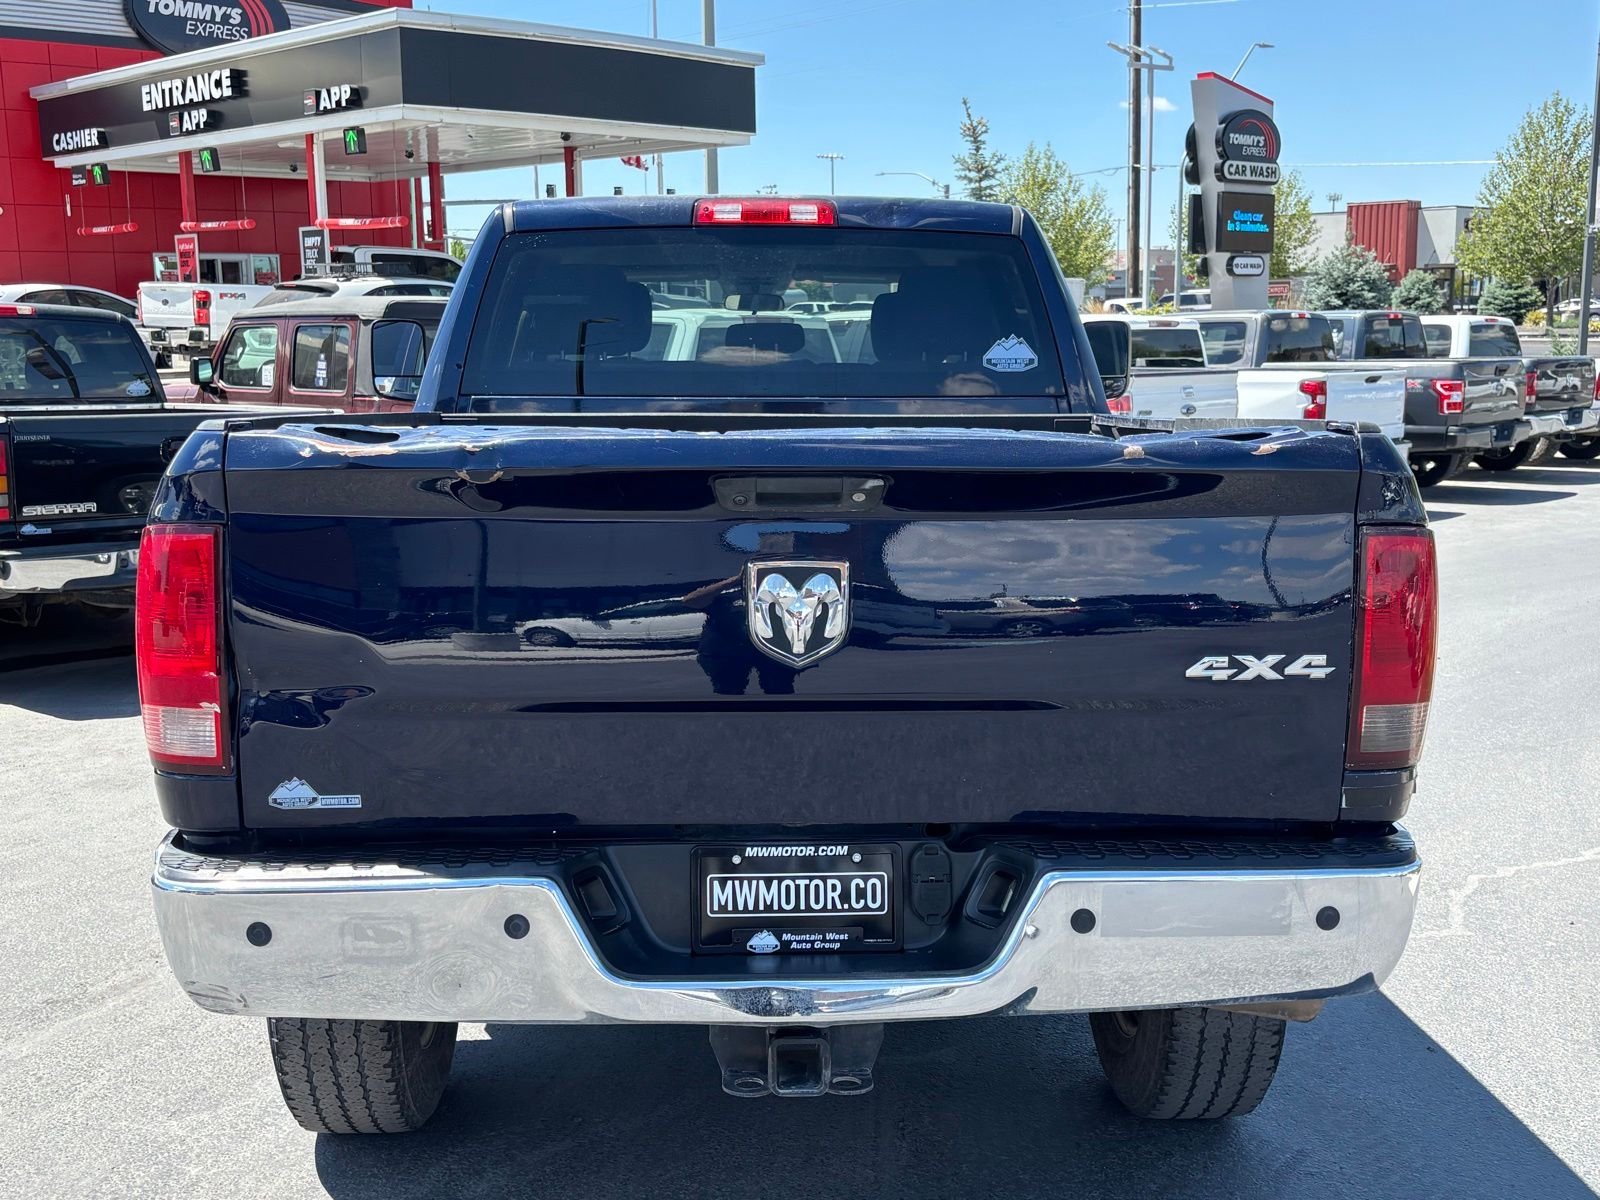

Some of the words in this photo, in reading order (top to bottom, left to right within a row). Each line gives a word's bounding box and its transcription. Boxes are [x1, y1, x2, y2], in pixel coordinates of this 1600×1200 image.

[147, 0, 243, 24] TOMMY'S
[185, 20, 248, 40] EXPRESS
[141, 68, 233, 112] ENTRANCE
[319, 84, 351, 111] APP
[182, 108, 208, 132] APP
[52, 128, 100, 152] CASHIER
[1229, 133, 1265, 147] TOMMY'S
[1242, 146, 1267, 157] EXPRESS
[1227, 163, 1247, 177] CAR
[1249, 165, 1277, 179] WASH
[22, 502, 97, 516] SIERRA
[1185, 654, 1337, 681] 4X4
[745, 846, 848, 857] MWMOTOR.COM
[712, 878, 882, 911] MWMOTOR.CO
[782, 933, 823, 941] Mountain
